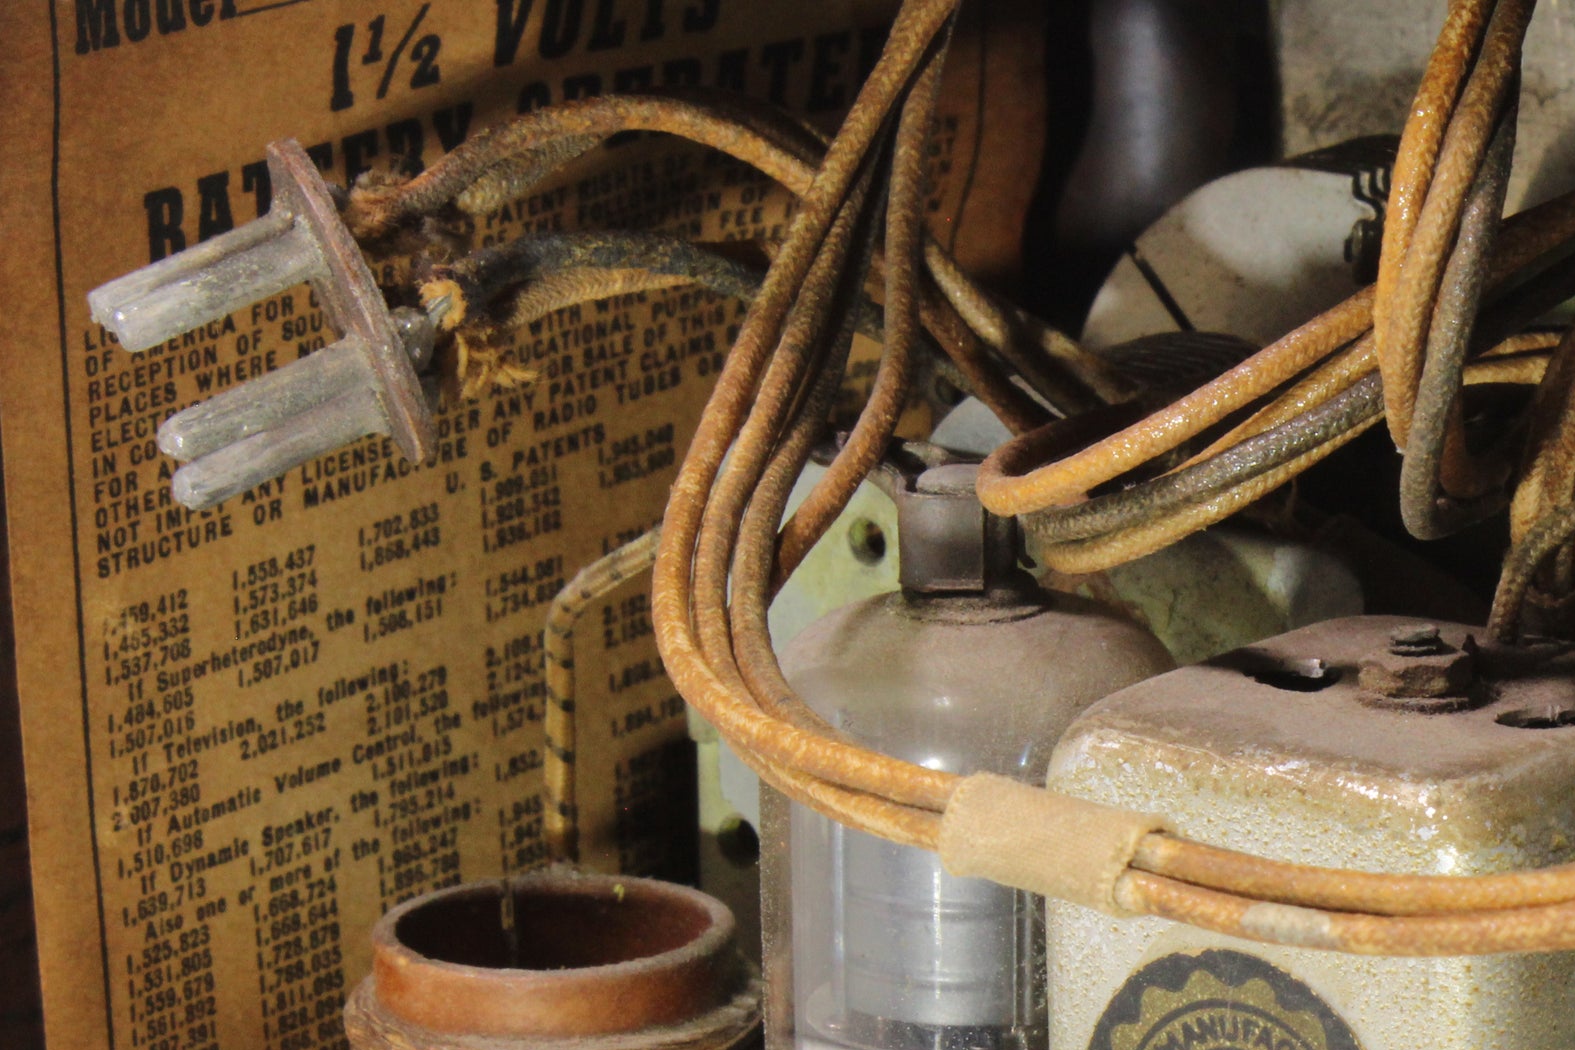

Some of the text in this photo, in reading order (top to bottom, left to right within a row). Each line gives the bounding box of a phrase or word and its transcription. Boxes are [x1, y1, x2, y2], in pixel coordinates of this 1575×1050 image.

[86, 351, 113, 377] OF
[252, 296, 294, 326] FOR
[88, 311, 324, 400] RECEPTION OF SOU
[89, 381, 178, 429] PLACES
[195, 351, 279, 394] WHERE
[92, 453, 117, 479] IN
[94, 469, 139, 504] FOR
[97, 520, 141, 554] NOT
[241, 473, 287, 506] ANY
[301, 437, 394, 486] LICENSE
[493, 391, 536, 423] ANY
[550, 358, 629, 404] PATENT
[97, 514, 234, 579] STRUCTURE
[253, 498, 283, 527] OR
[303, 436, 468, 508] MANUFACURE
[487, 421, 514, 449] OF
[533, 394, 598, 433] RADIO
[616, 365, 683, 405] TUBES
[512, 422, 607, 472] PATENTS
[95, 485, 171, 529] OTHER
[326, 608, 355, 633] the
[276, 700, 305, 723] the
[318, 658, 409, 708] following:
[167, 785, 262, 836] Automatic
[274, 756, 342, 795] Volume
[434, 712, 462, 735] the
[170, 836, 250, 883] Dynamic
[351, 790, 380, 814] the
[145, 912, 184, 942] Also
[197, 898, 228, 922] one
[239, 885, 256, 907] or
[269, 864, 313, 893] more
[324, 848, 342, 873] of
[352, 836, 381, 862] the
